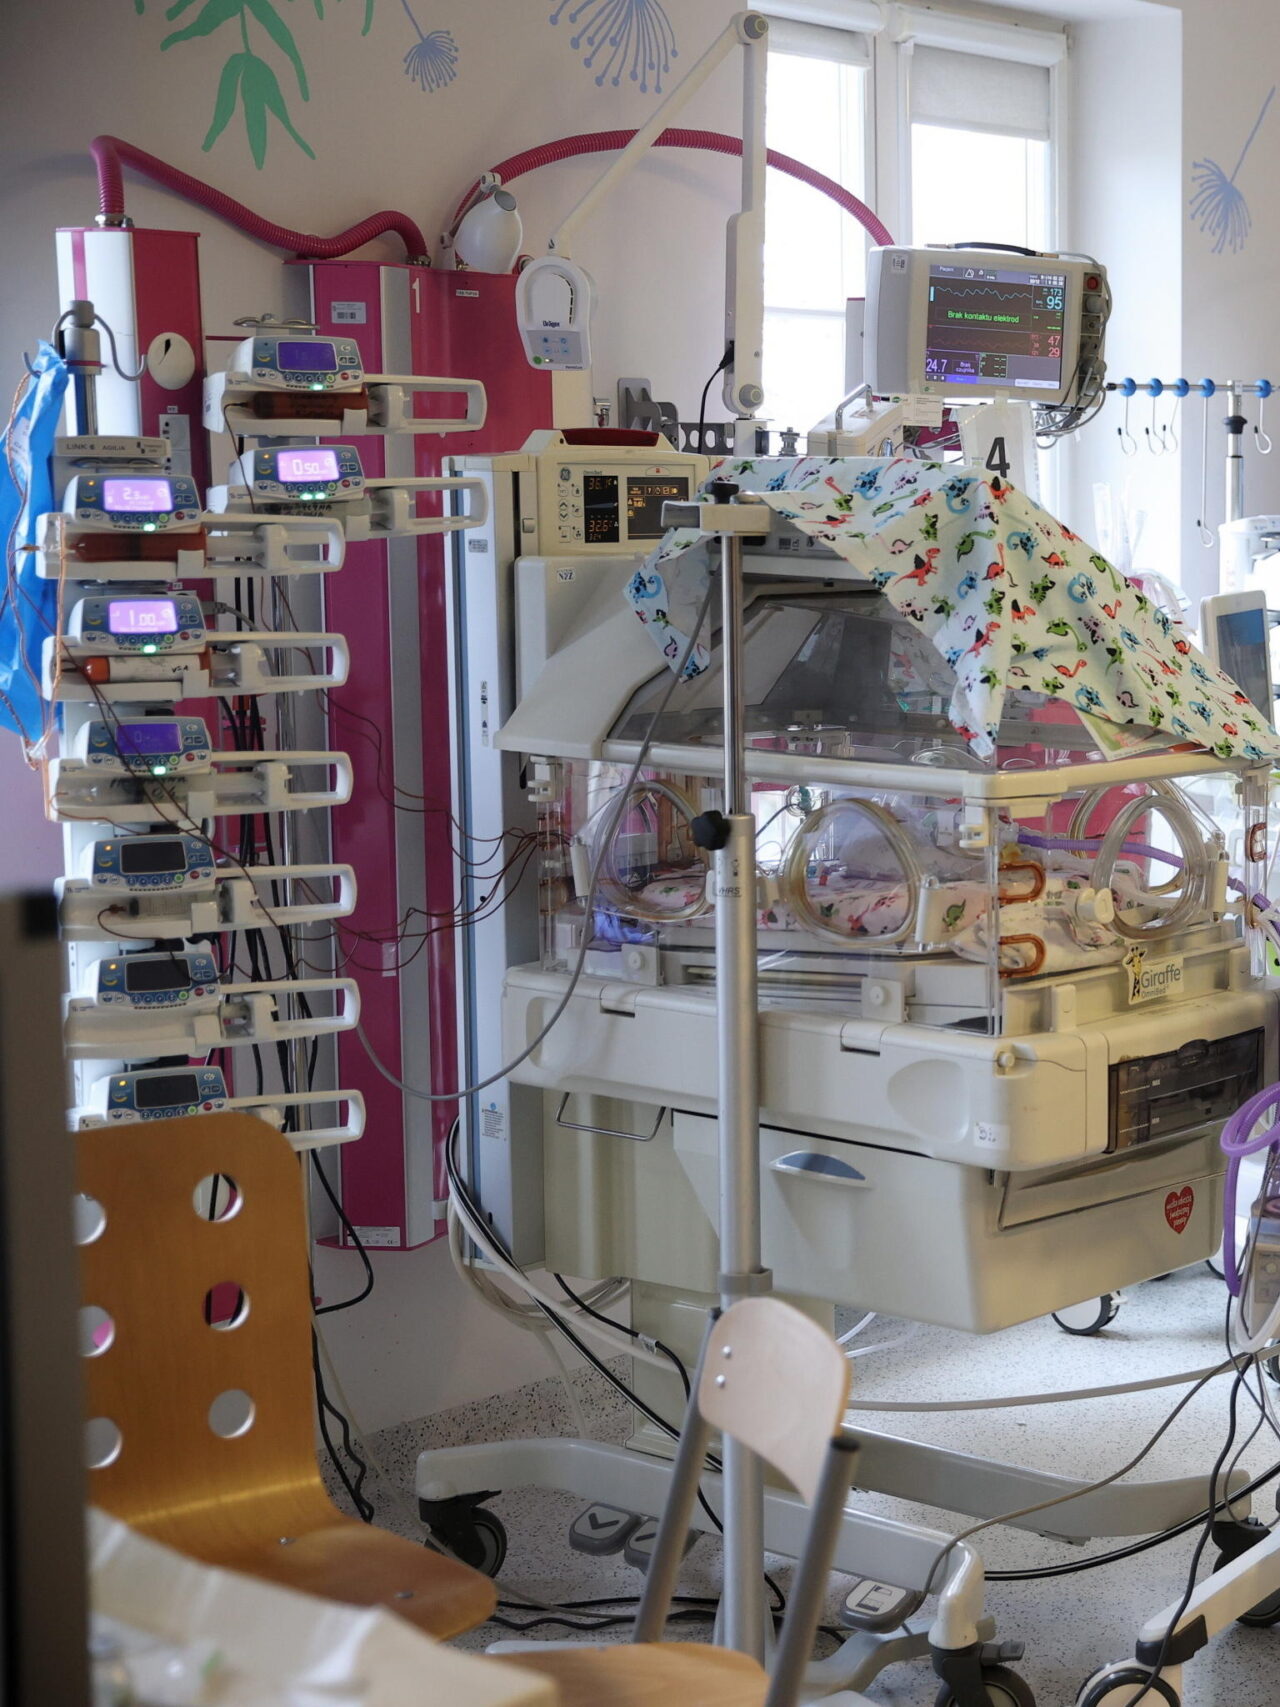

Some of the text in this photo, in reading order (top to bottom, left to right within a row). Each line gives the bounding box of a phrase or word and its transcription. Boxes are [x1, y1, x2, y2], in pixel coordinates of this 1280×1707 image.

[412, 277, 420, 314] 1
[1046, 296, 1062, 310] 95
[947, 310, 1020, 323] Brak kontaktu elektrod
[1048, 335, 1060, 345] 47
[926, 358, 947, 372] 24.7
[985, 436, 1010, 478] 4
[1141, 963, 1181, 989] Giraffe
